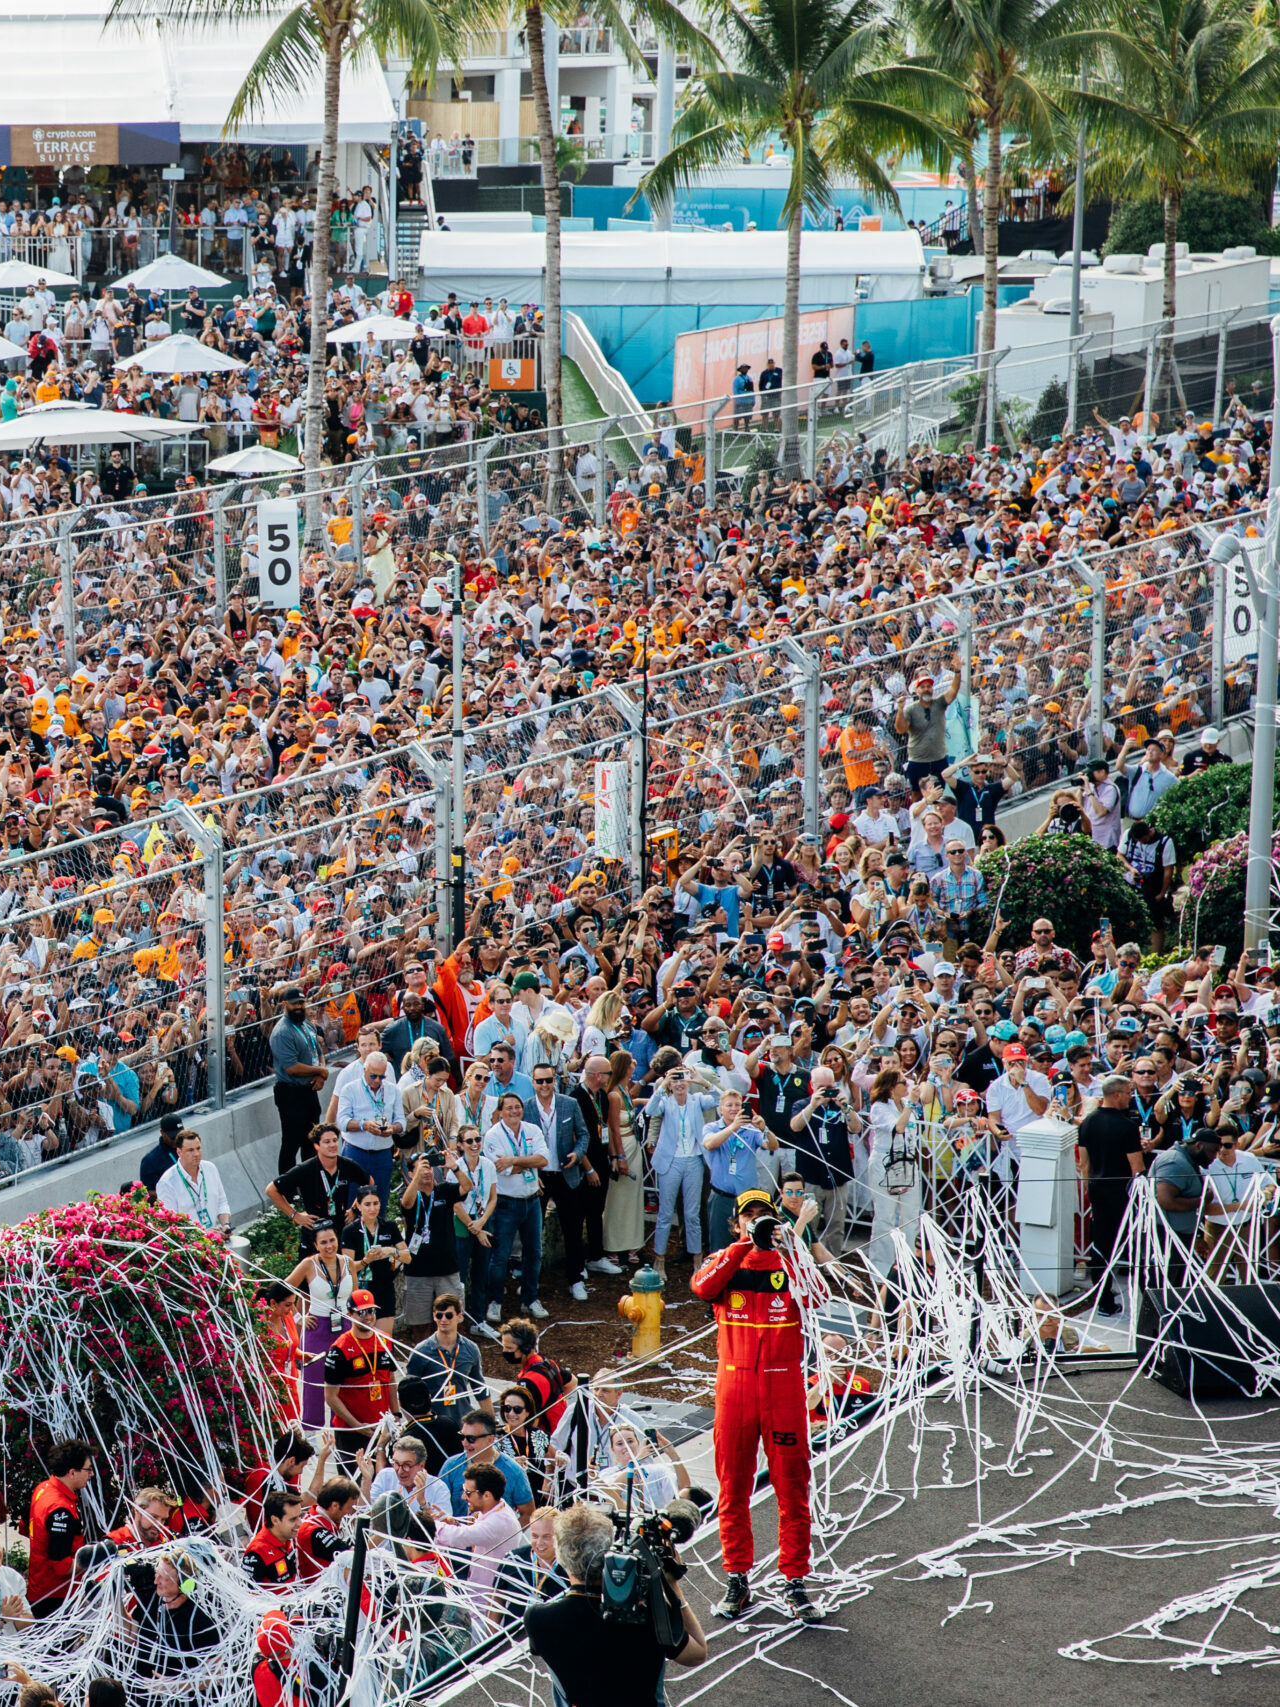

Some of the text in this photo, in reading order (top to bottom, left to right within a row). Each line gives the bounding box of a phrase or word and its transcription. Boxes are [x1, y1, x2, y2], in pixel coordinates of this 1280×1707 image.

[46, 130, 97, 139] crypto.com
[33, 141, 97, 153] TERRACE
[39, 153, 90, 162] SUITES
[267, 523, 292, 586] 50
[772, 1431, 798, 1446] 55
